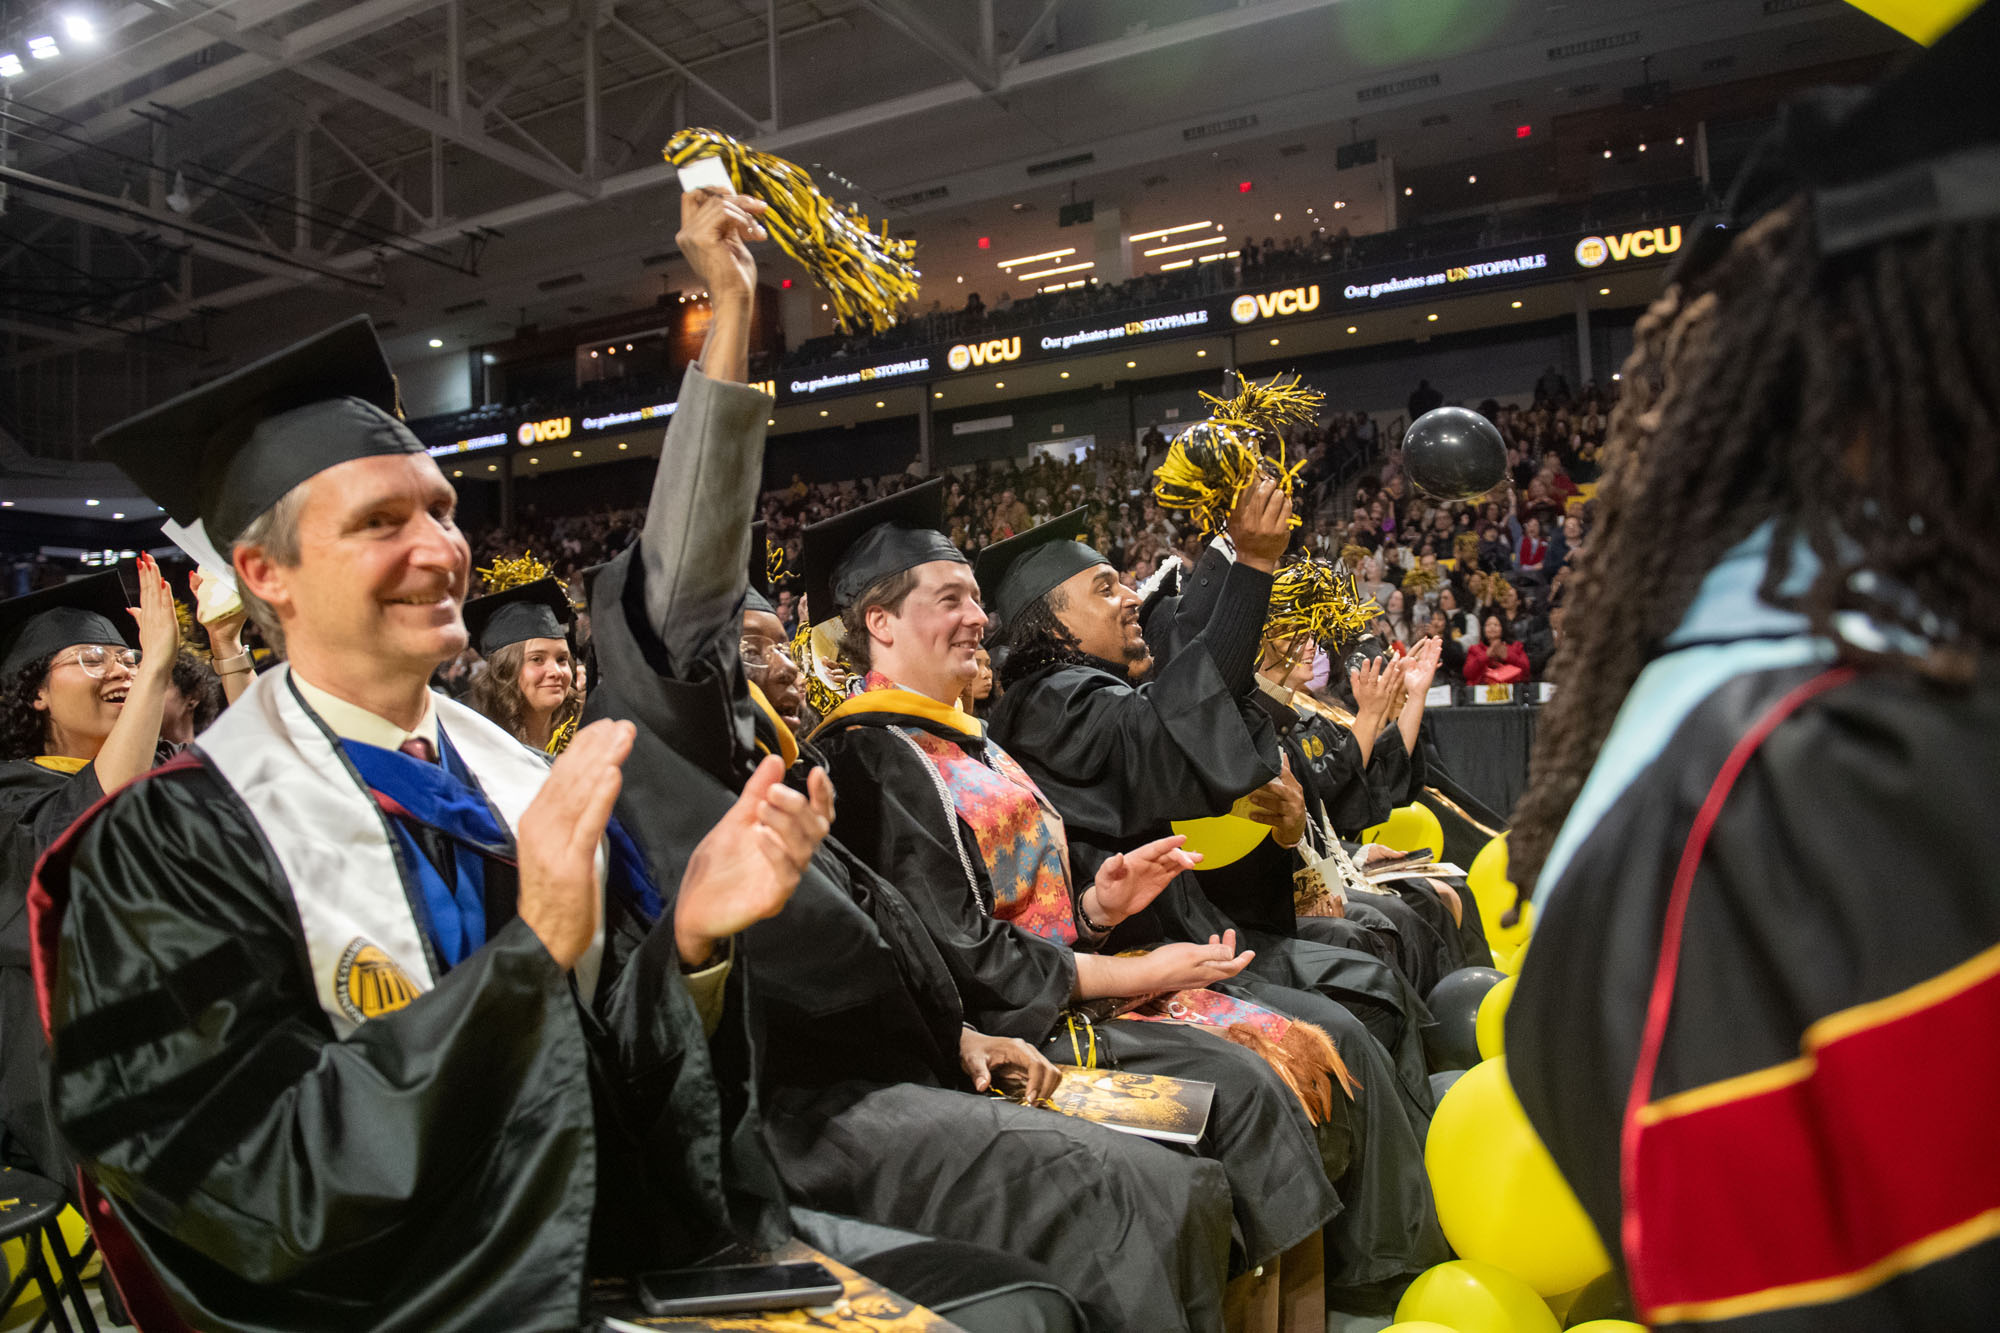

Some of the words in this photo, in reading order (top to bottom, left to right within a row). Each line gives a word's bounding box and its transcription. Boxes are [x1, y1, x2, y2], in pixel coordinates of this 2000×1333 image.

[1605, 225, 1682, 261] VCU
[1344, 285, 1370, 299] Our
[1370, 277, 1426, 298] graduates
[1426, 271, 1447, 286] are
[1446, 254, 1547, 282] UNSTOPPABLE
[1256, 285, 1320, 318] VCU
[1041, 337, 1062, 349] Our
[1062, 330, 1108, 349] graduates
[1108, 327, 1125, 338] are
[1125, 310, 1208, 335] UNSTOPPABLE
[969, 336, 1021, 366] VCU
[860, 358, 929, 381] UNSTOPPABLE
[534, 417, 571, 442] VCU
